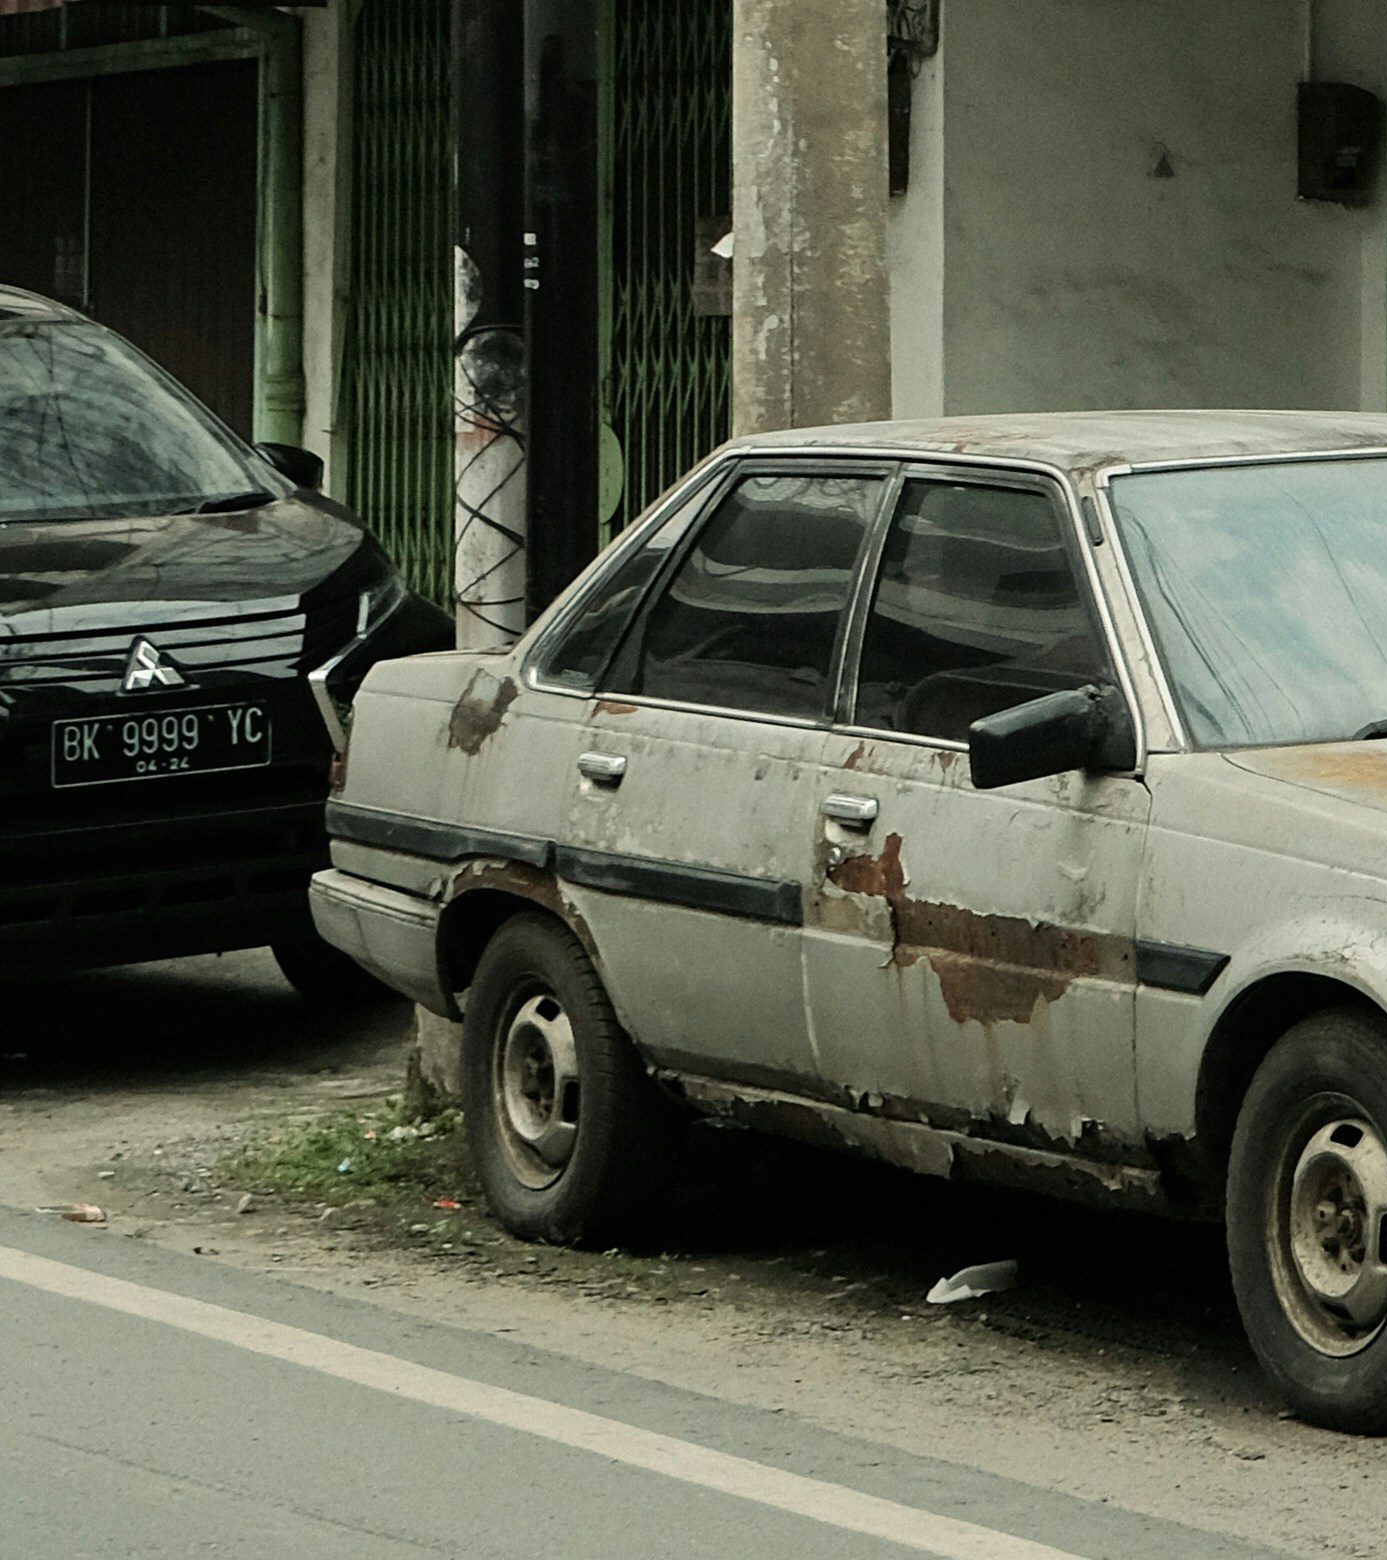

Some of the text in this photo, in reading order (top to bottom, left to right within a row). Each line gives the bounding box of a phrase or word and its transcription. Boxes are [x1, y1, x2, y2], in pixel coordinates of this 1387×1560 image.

[63, 706, 263, 761] BK 9999 YC
